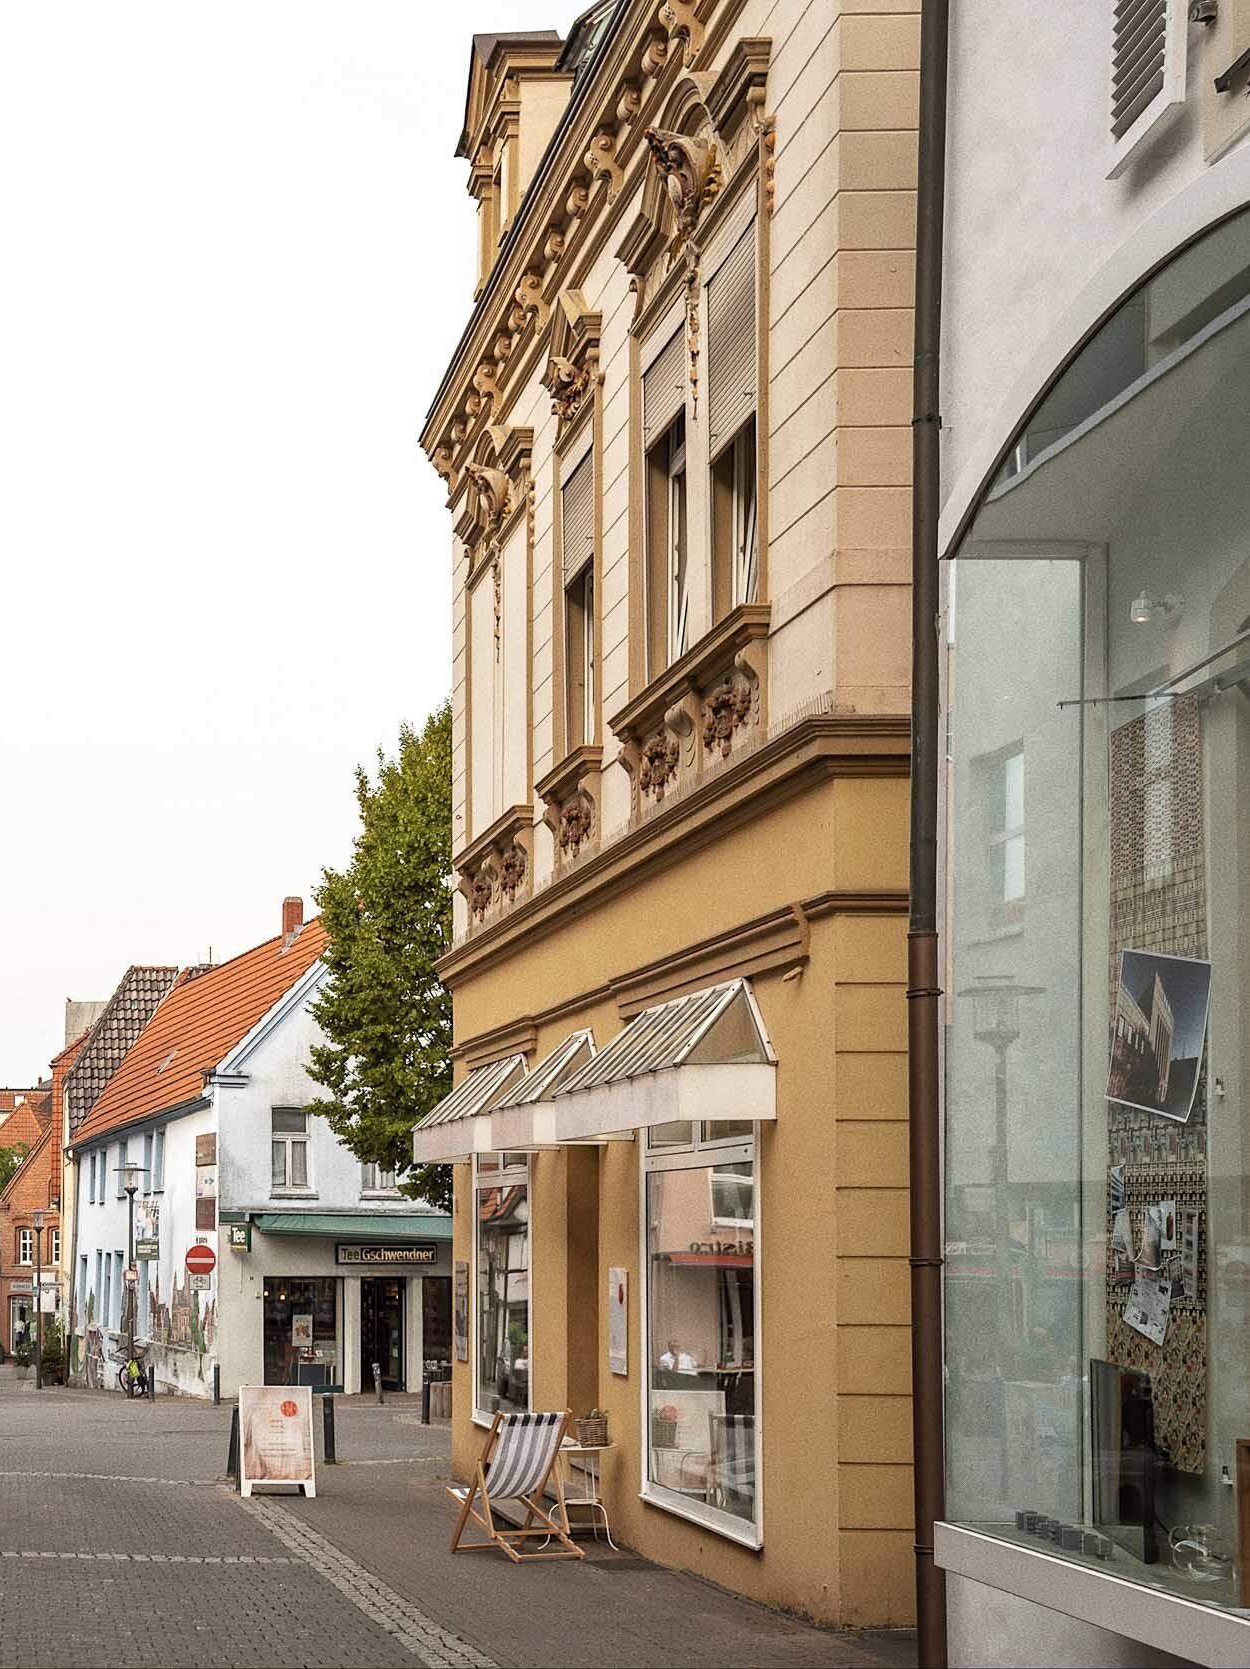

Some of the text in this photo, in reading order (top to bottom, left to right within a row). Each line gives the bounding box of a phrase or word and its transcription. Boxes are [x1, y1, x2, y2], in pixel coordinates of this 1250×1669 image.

[231, 1227, 246, 1243] Tee
[341, 1247, 435, 1262] Tee Gschwendner
